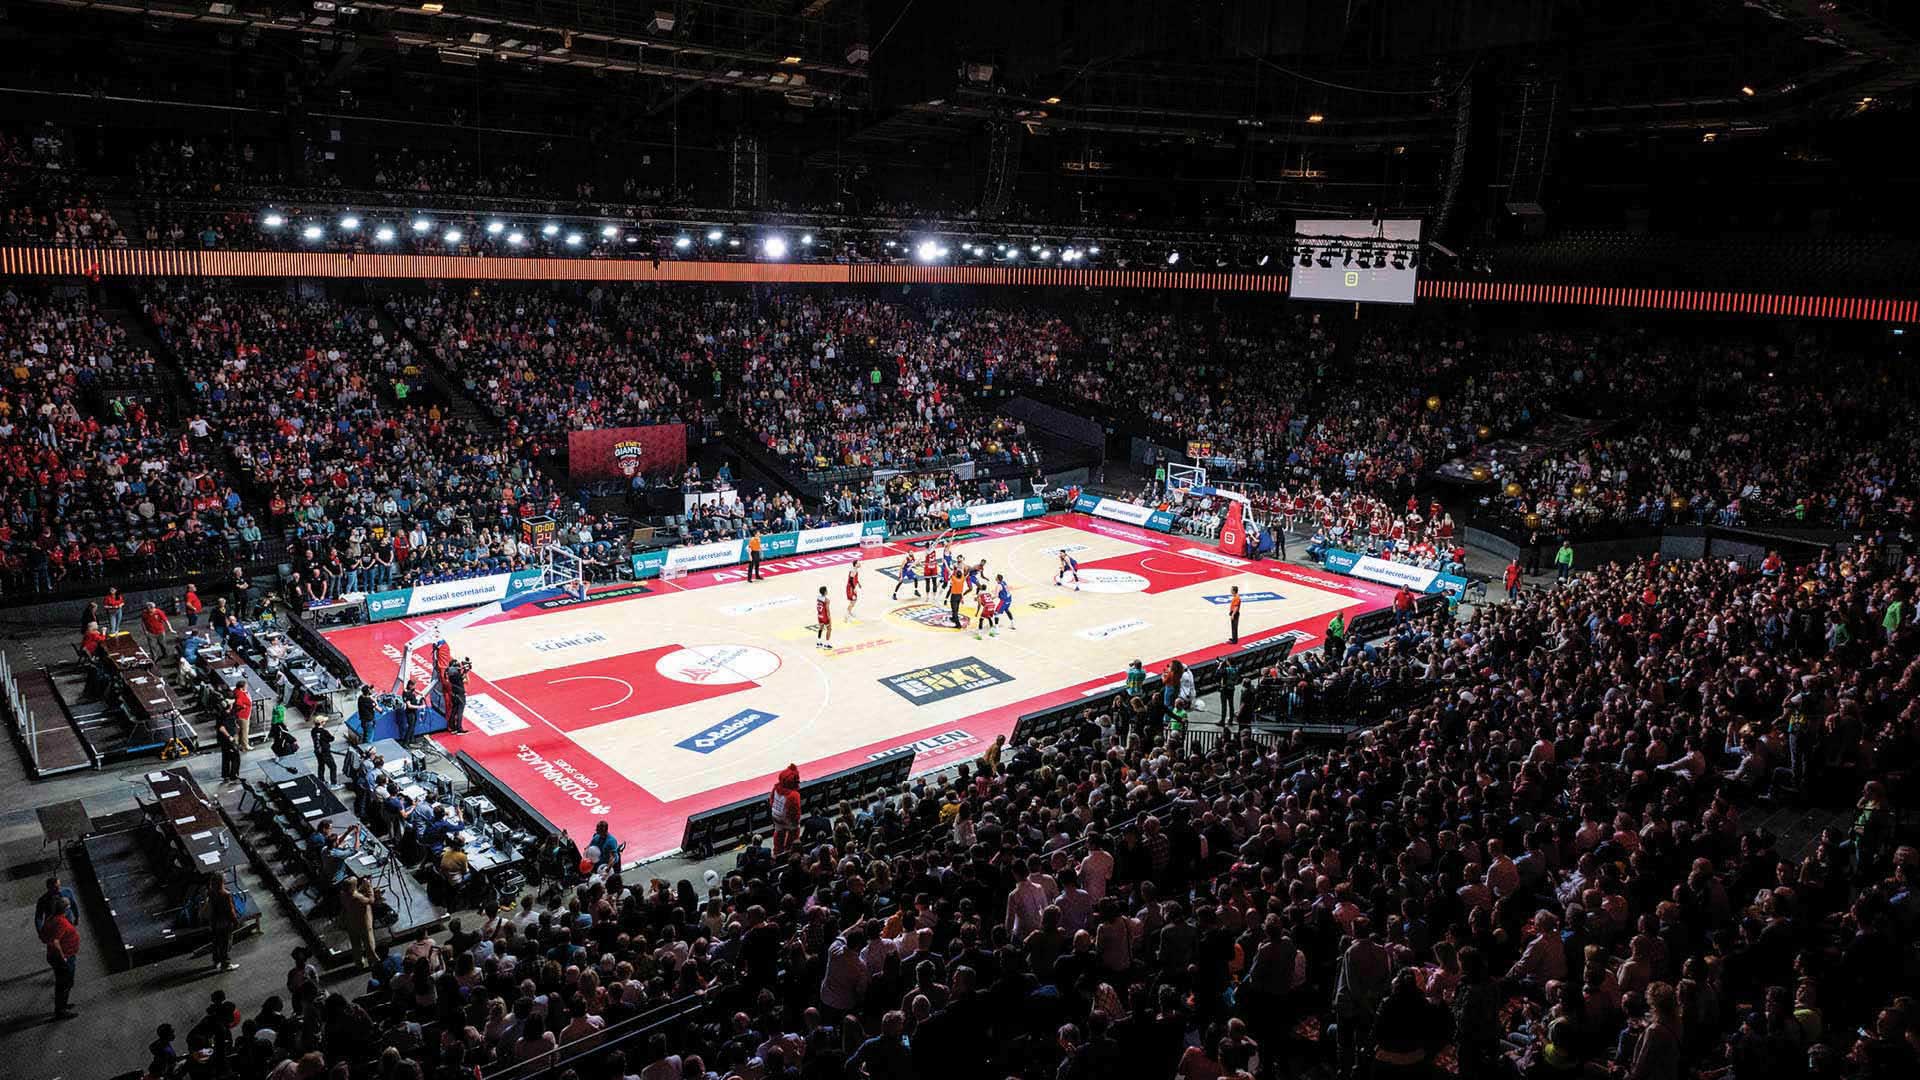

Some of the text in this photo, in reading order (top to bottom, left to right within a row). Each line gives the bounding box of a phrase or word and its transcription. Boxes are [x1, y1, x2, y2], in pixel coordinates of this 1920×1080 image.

[614, 446, 642, 457] GIANTS
[535, 522, 555, 533] 10:00
[536, 532, 552, 546] 24
[1363, 564, 1421, 583] sociaal secretariaat
[421, 585, 496, 603] sociaal secretariaat
[535, 633, 607, 652] SCANCAR
[896, 663, 992, 697] BNXT
[706, 713, 761, 741] Baloise
